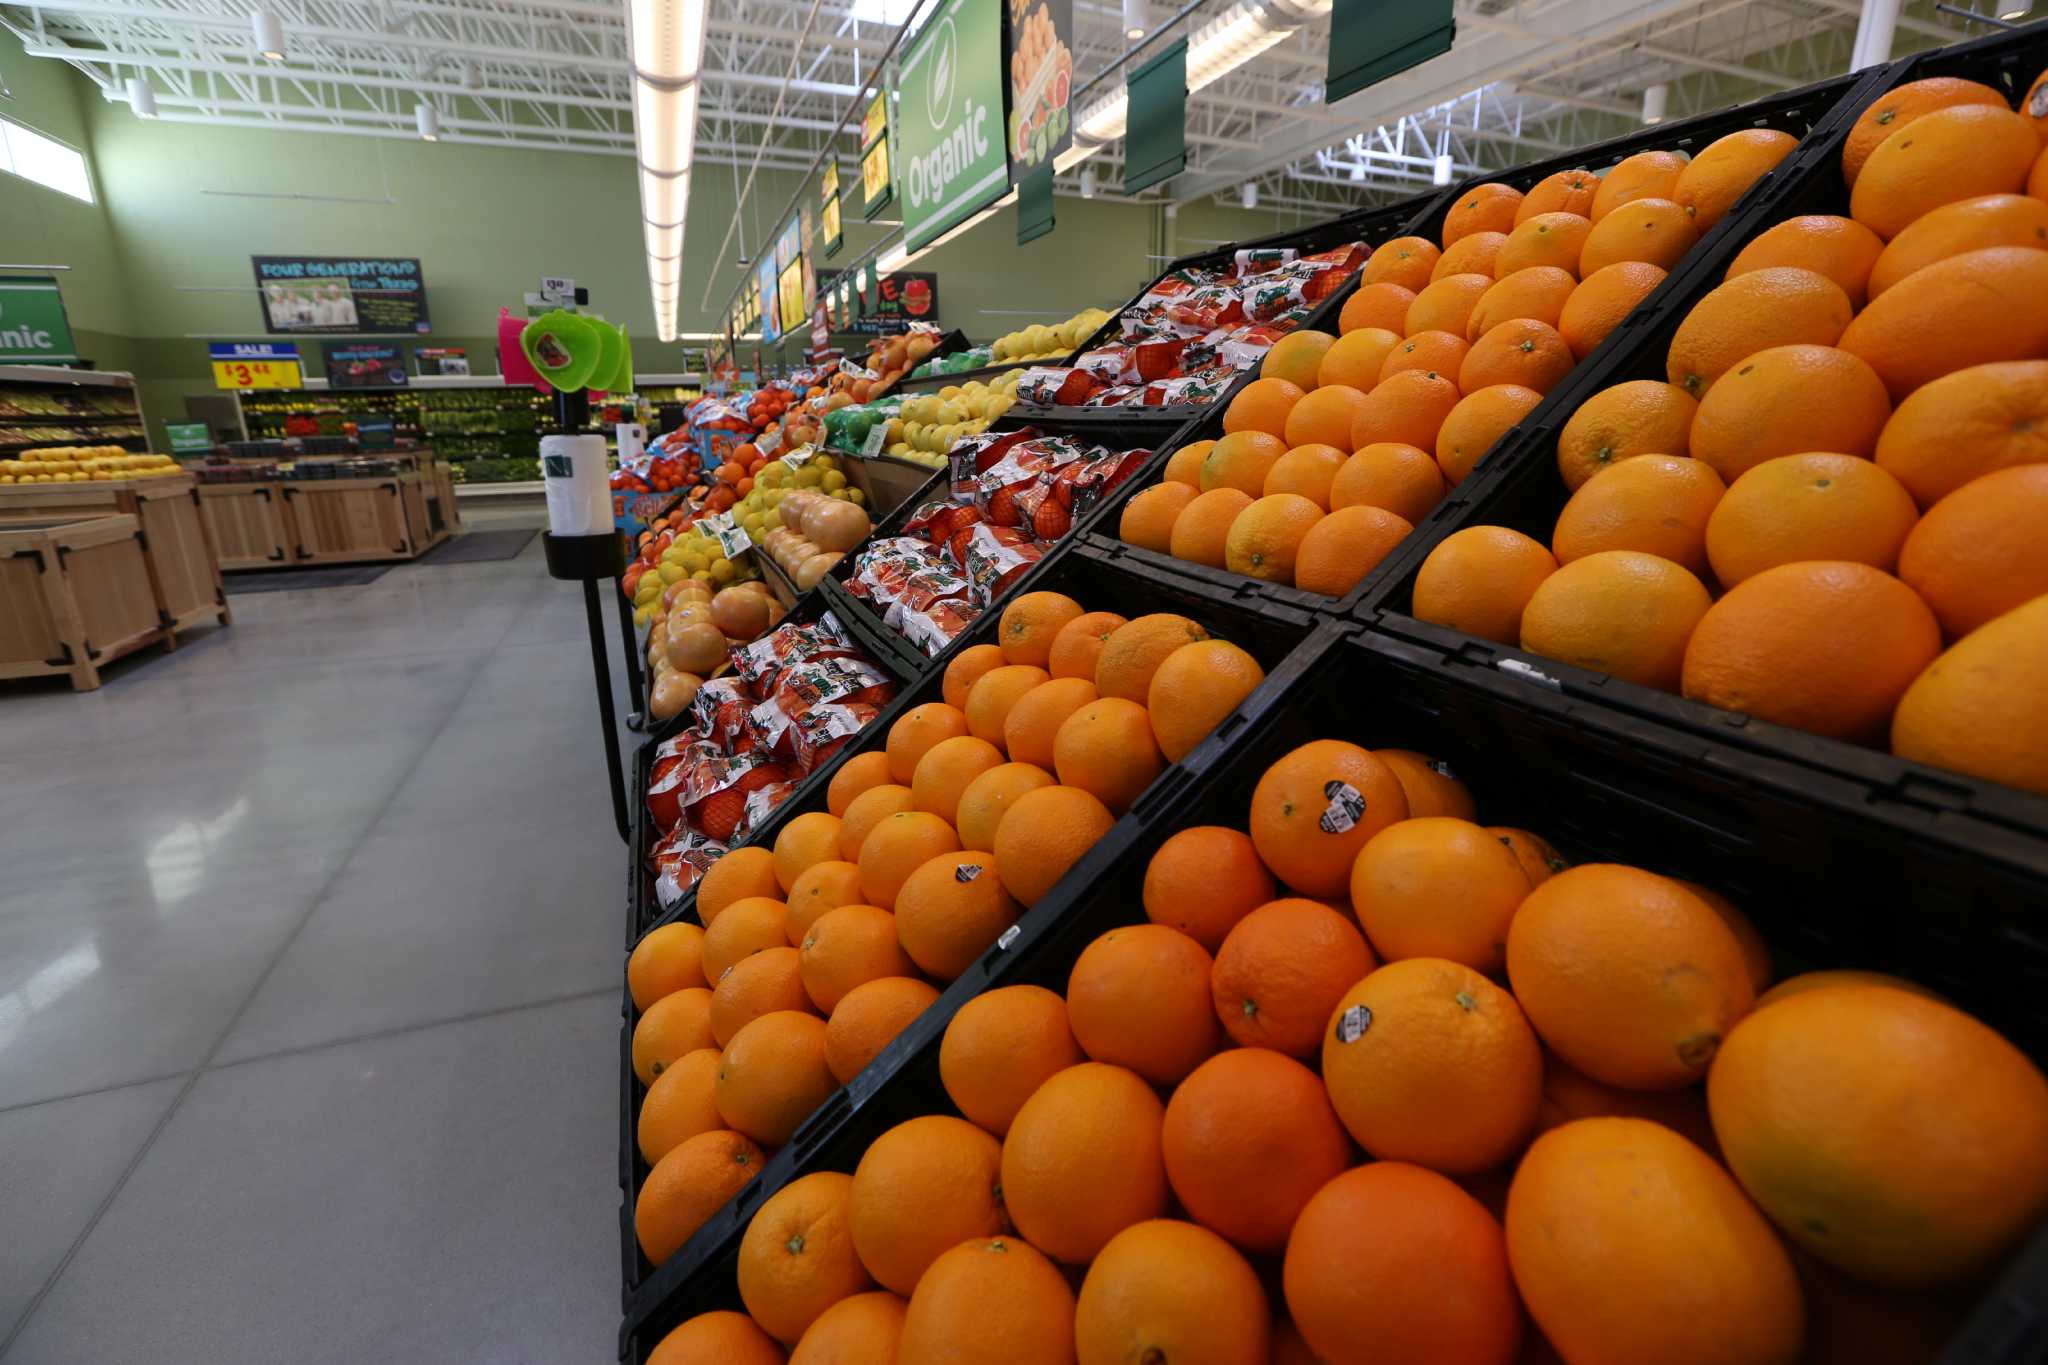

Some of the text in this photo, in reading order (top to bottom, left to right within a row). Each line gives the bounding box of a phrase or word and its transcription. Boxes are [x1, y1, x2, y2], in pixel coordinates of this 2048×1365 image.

[909, 97, 988, 208] Organic
[260, 261, 417, 277] FOUR GENERATIONS
[0, 325, 54, 349] nic
